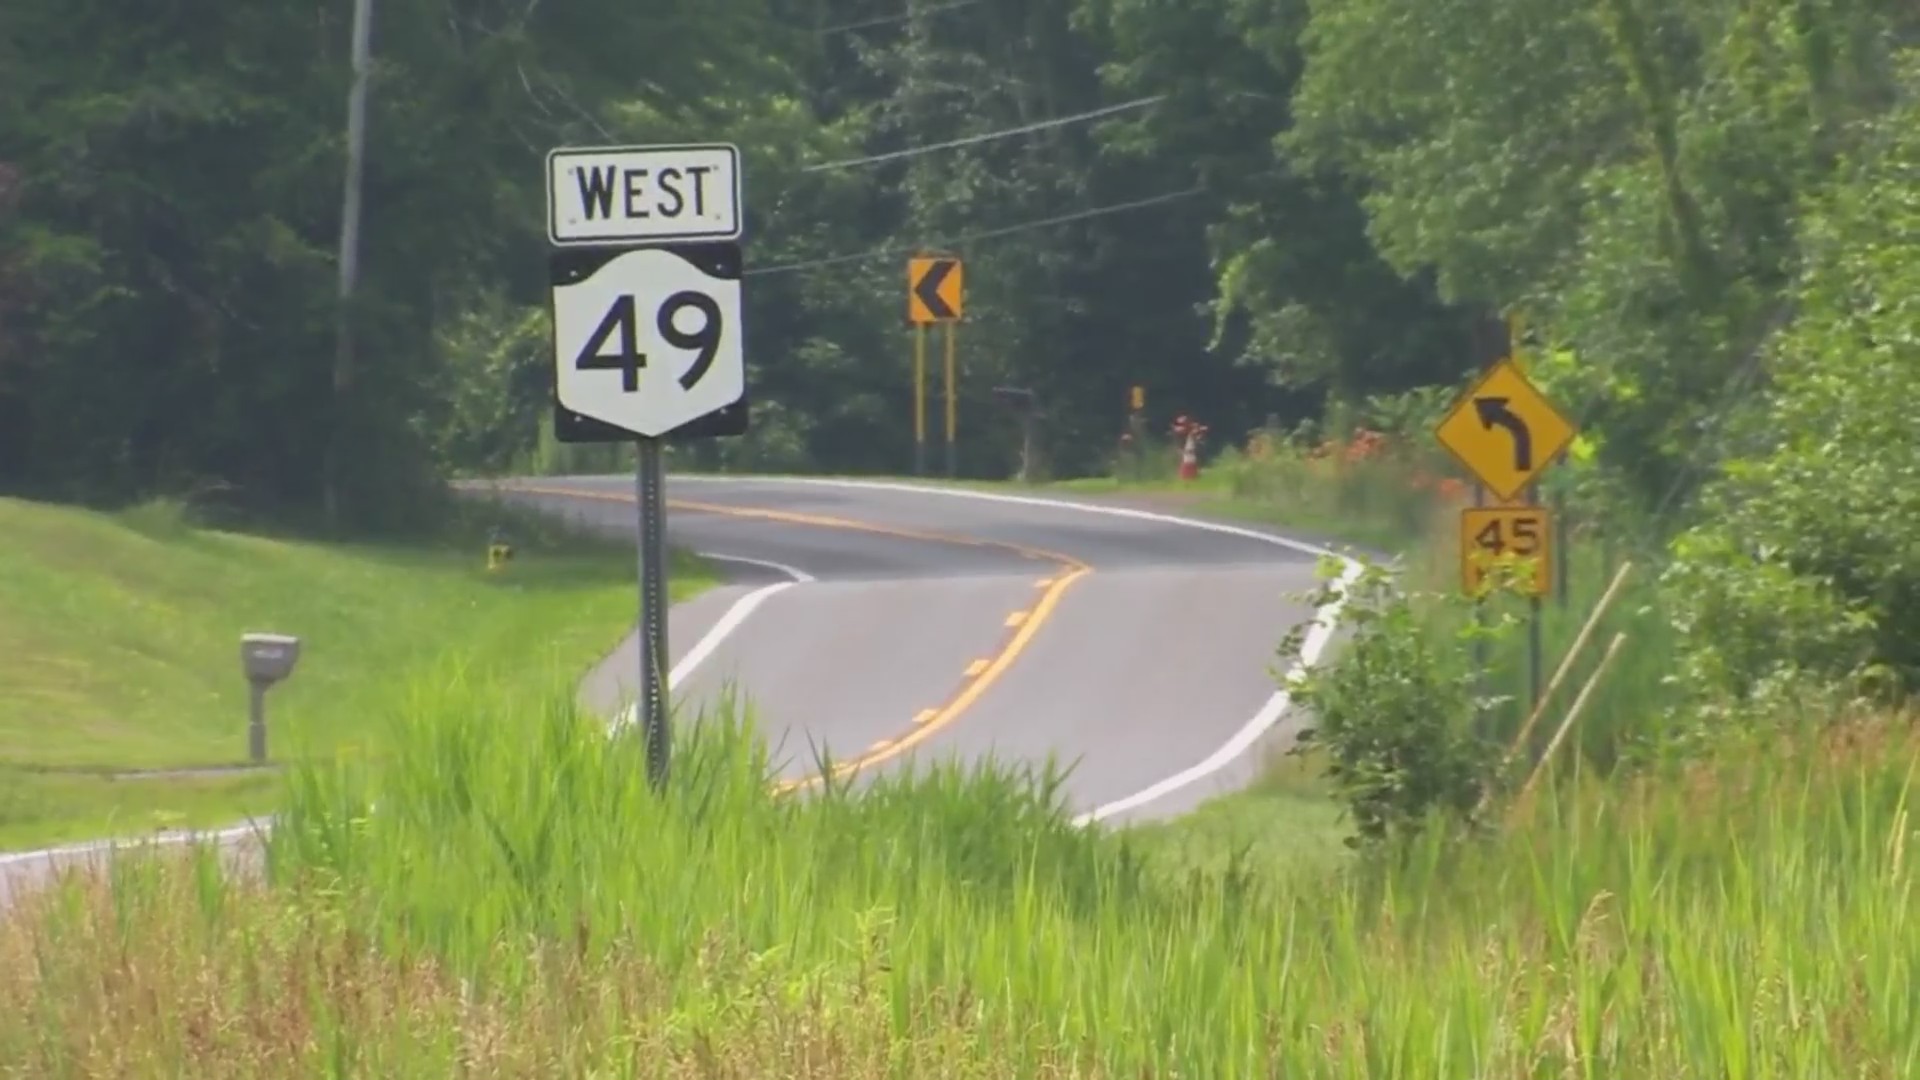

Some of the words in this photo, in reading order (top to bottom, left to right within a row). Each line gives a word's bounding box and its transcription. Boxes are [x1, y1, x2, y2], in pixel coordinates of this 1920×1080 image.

[576, 165, 711, 220] WEST
[575, 290, 722, 393] 49
[1475, 517, 1538, 556] 45
